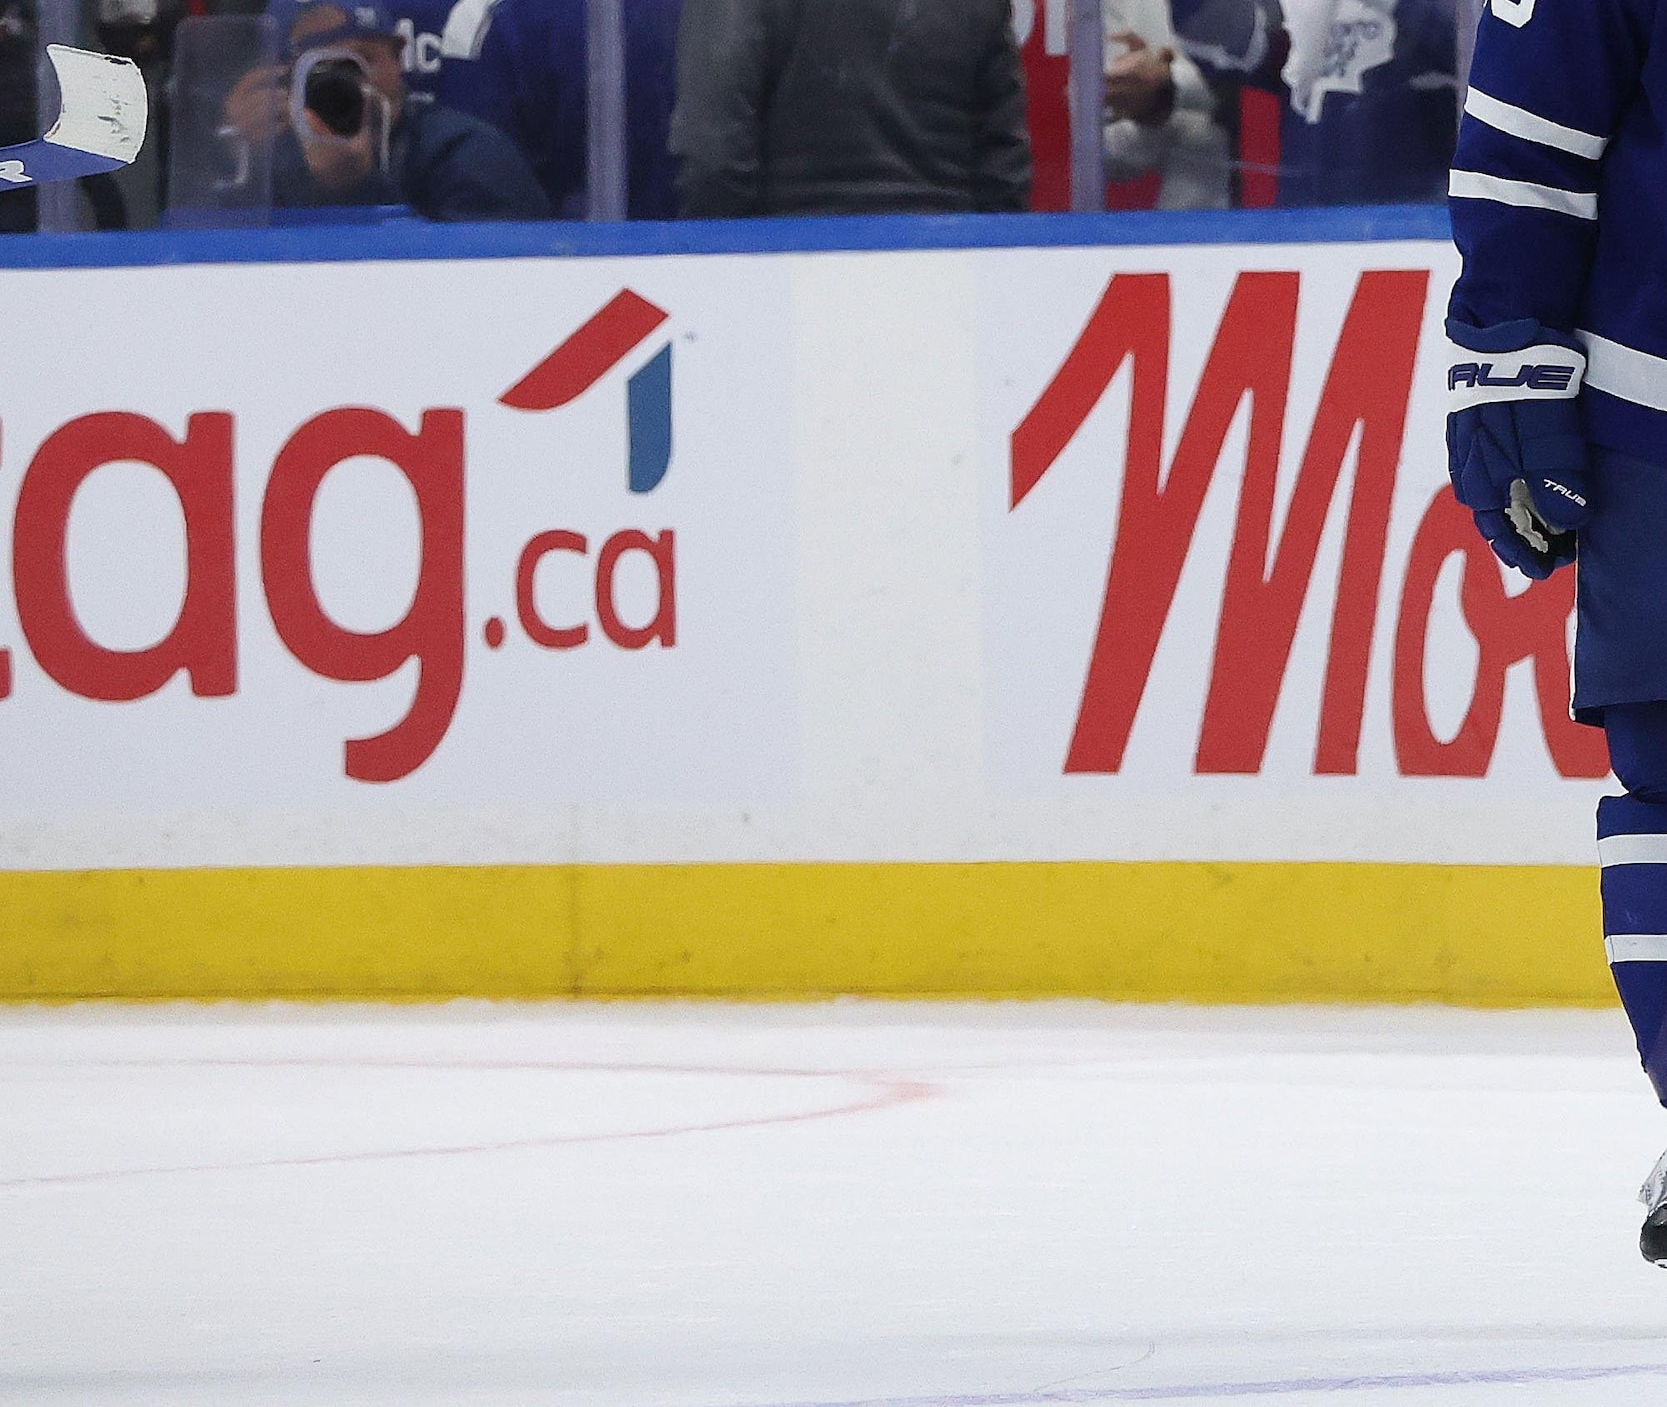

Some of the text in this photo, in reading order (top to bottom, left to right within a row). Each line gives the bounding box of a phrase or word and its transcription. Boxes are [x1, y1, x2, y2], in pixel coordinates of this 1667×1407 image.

[1448, 362, 1575, 391] RUE
[1544, 478, 1587, 508] TRUE
[0, 407, 676, 785] ag.ca
